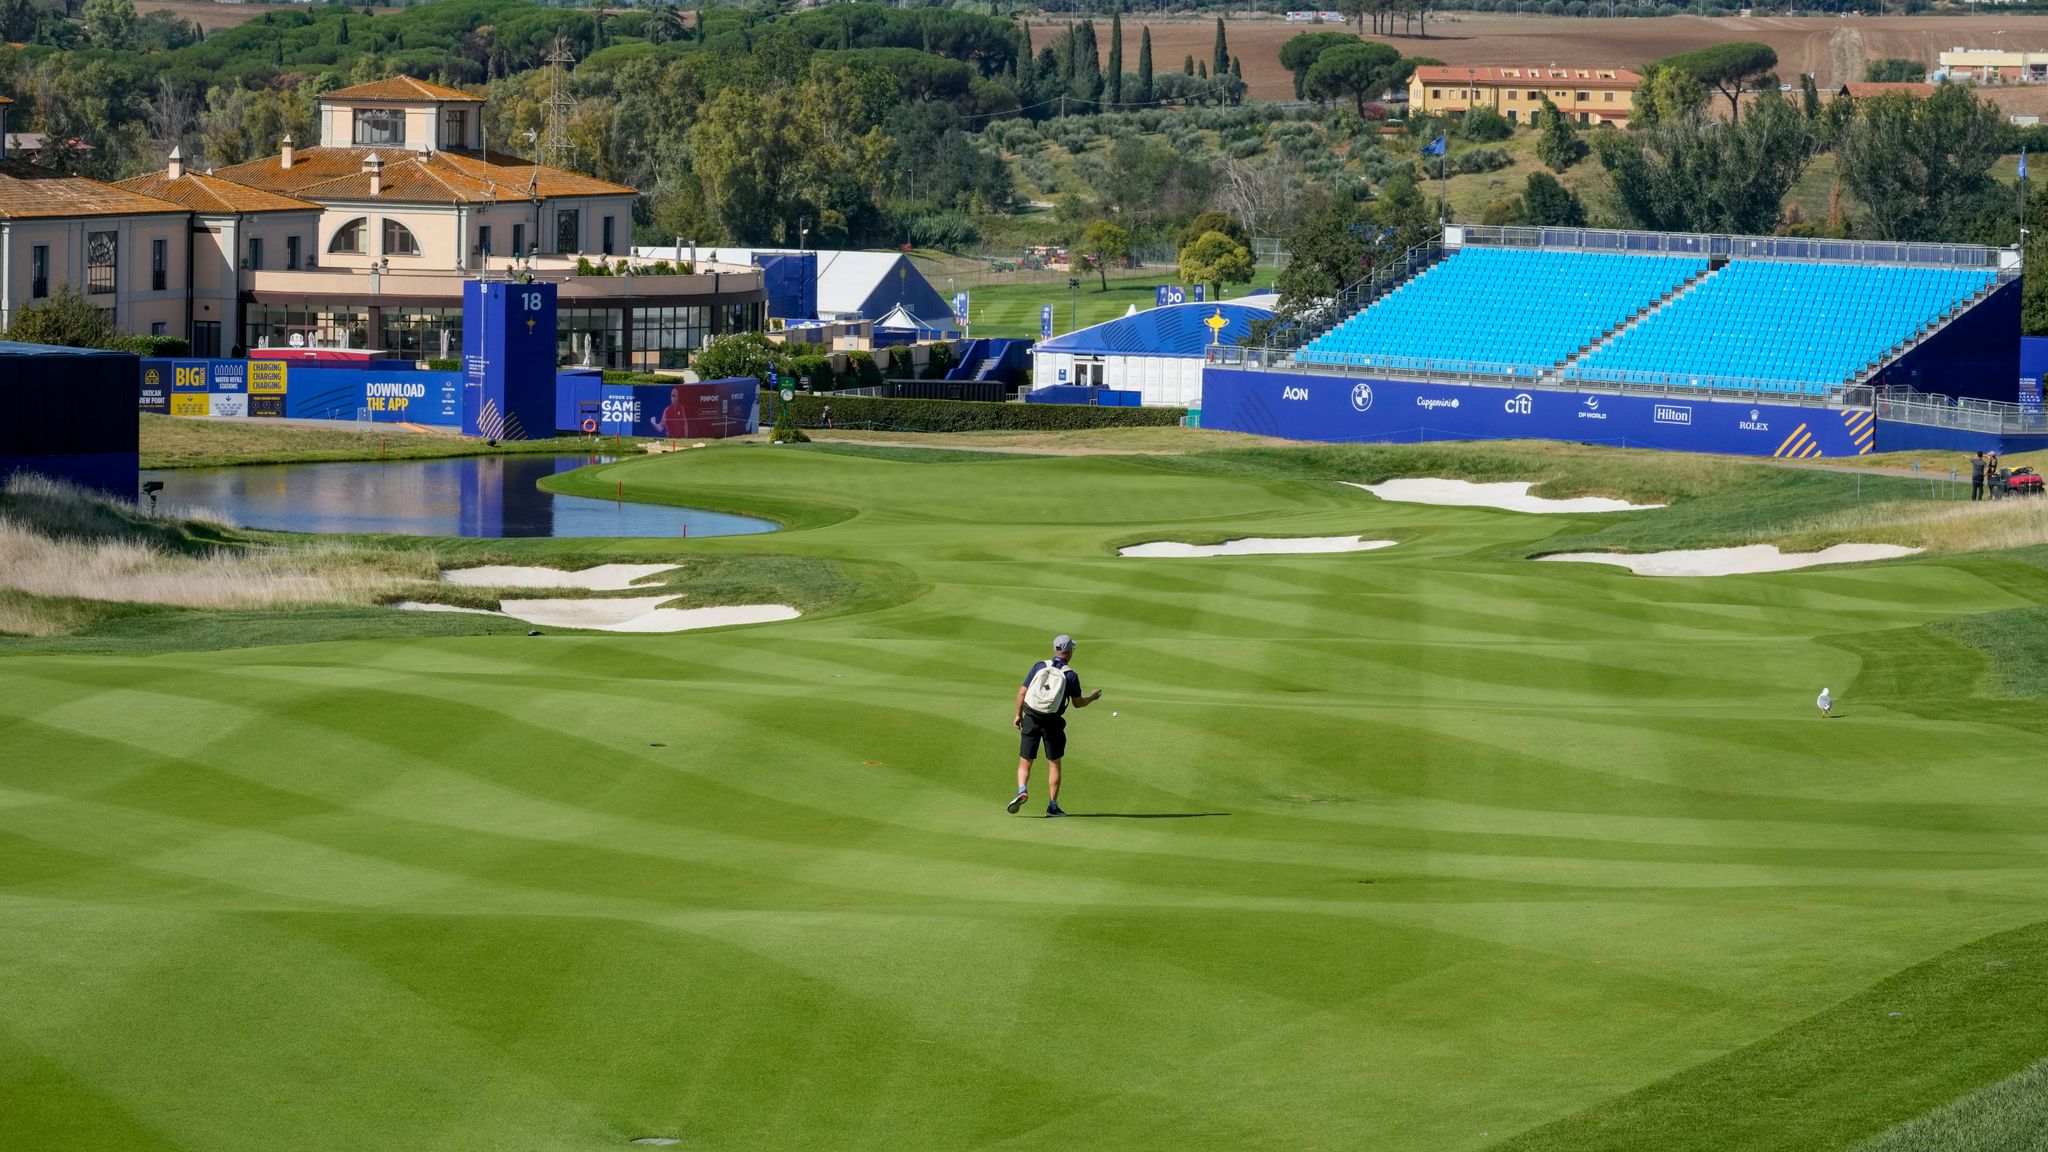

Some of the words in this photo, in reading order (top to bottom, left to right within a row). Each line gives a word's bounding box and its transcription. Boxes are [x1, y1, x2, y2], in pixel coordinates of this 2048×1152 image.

[521, 292, 541, 311] 18
[253, 363, 282, 371] CHARGING
[175, 367, 200, 386] BIG
[253, 372, 282, 380] CHARGING
[253, 381, 282, 390] CHARGING
[366, 383, 425, 398] DOWNLOAD
[1282, 386, 1309, 401] AON
[366, 397, 386, 411] THE
[387, 397, 409, 411] APP
[601, 400, 641, 411] GAME
[1416, 396, 1451, 411] Capgemini
[601, 410, 641, 422] ZONE
[1657, 408, 1688, 422] Hilton
[1739, 421, 1769, 432] ROLEX
